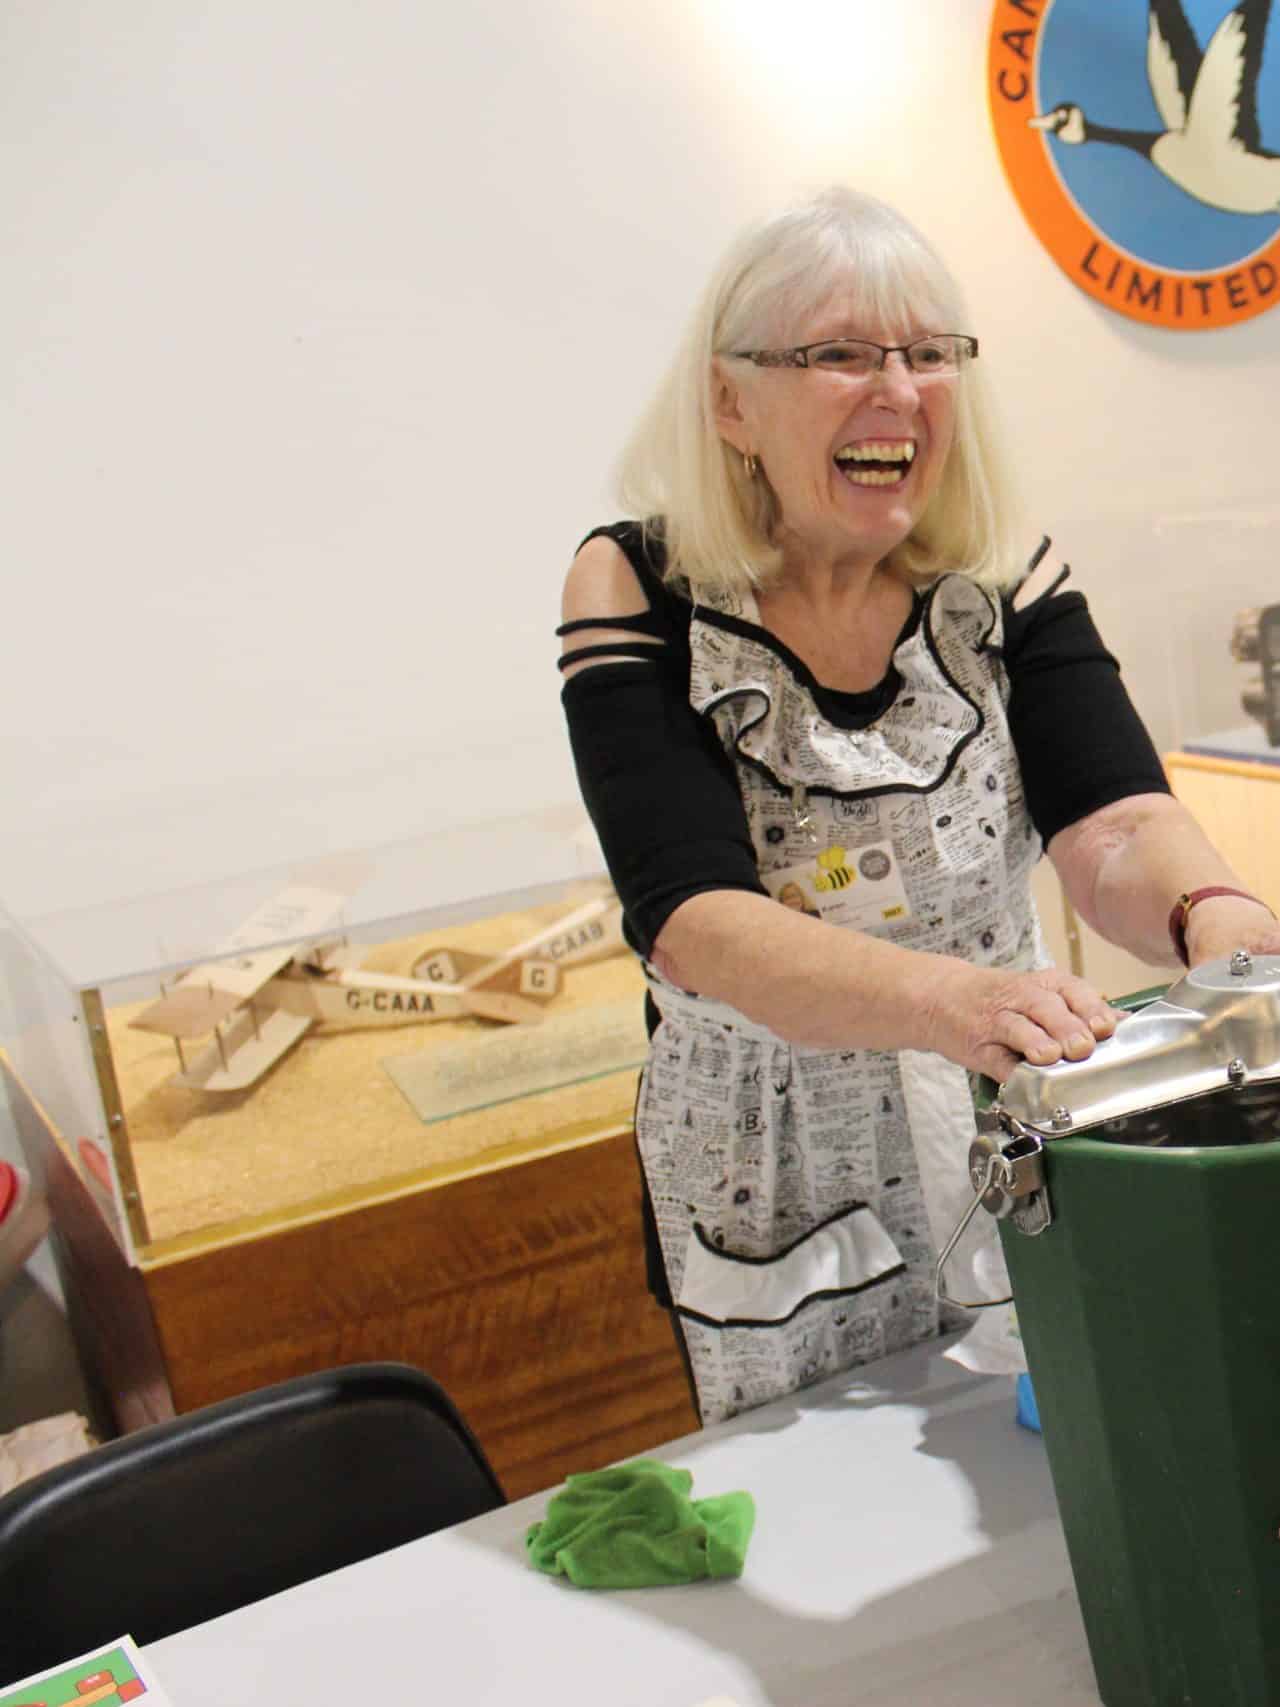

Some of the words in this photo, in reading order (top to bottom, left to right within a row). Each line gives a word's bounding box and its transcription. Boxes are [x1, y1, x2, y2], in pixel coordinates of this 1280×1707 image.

[1081, 242, 1278, 317] LIMITED
[427, 962, 444, 982] G
[530, 968, 546, 988] G
[345, 989, 435, 1012] G-CAAA
